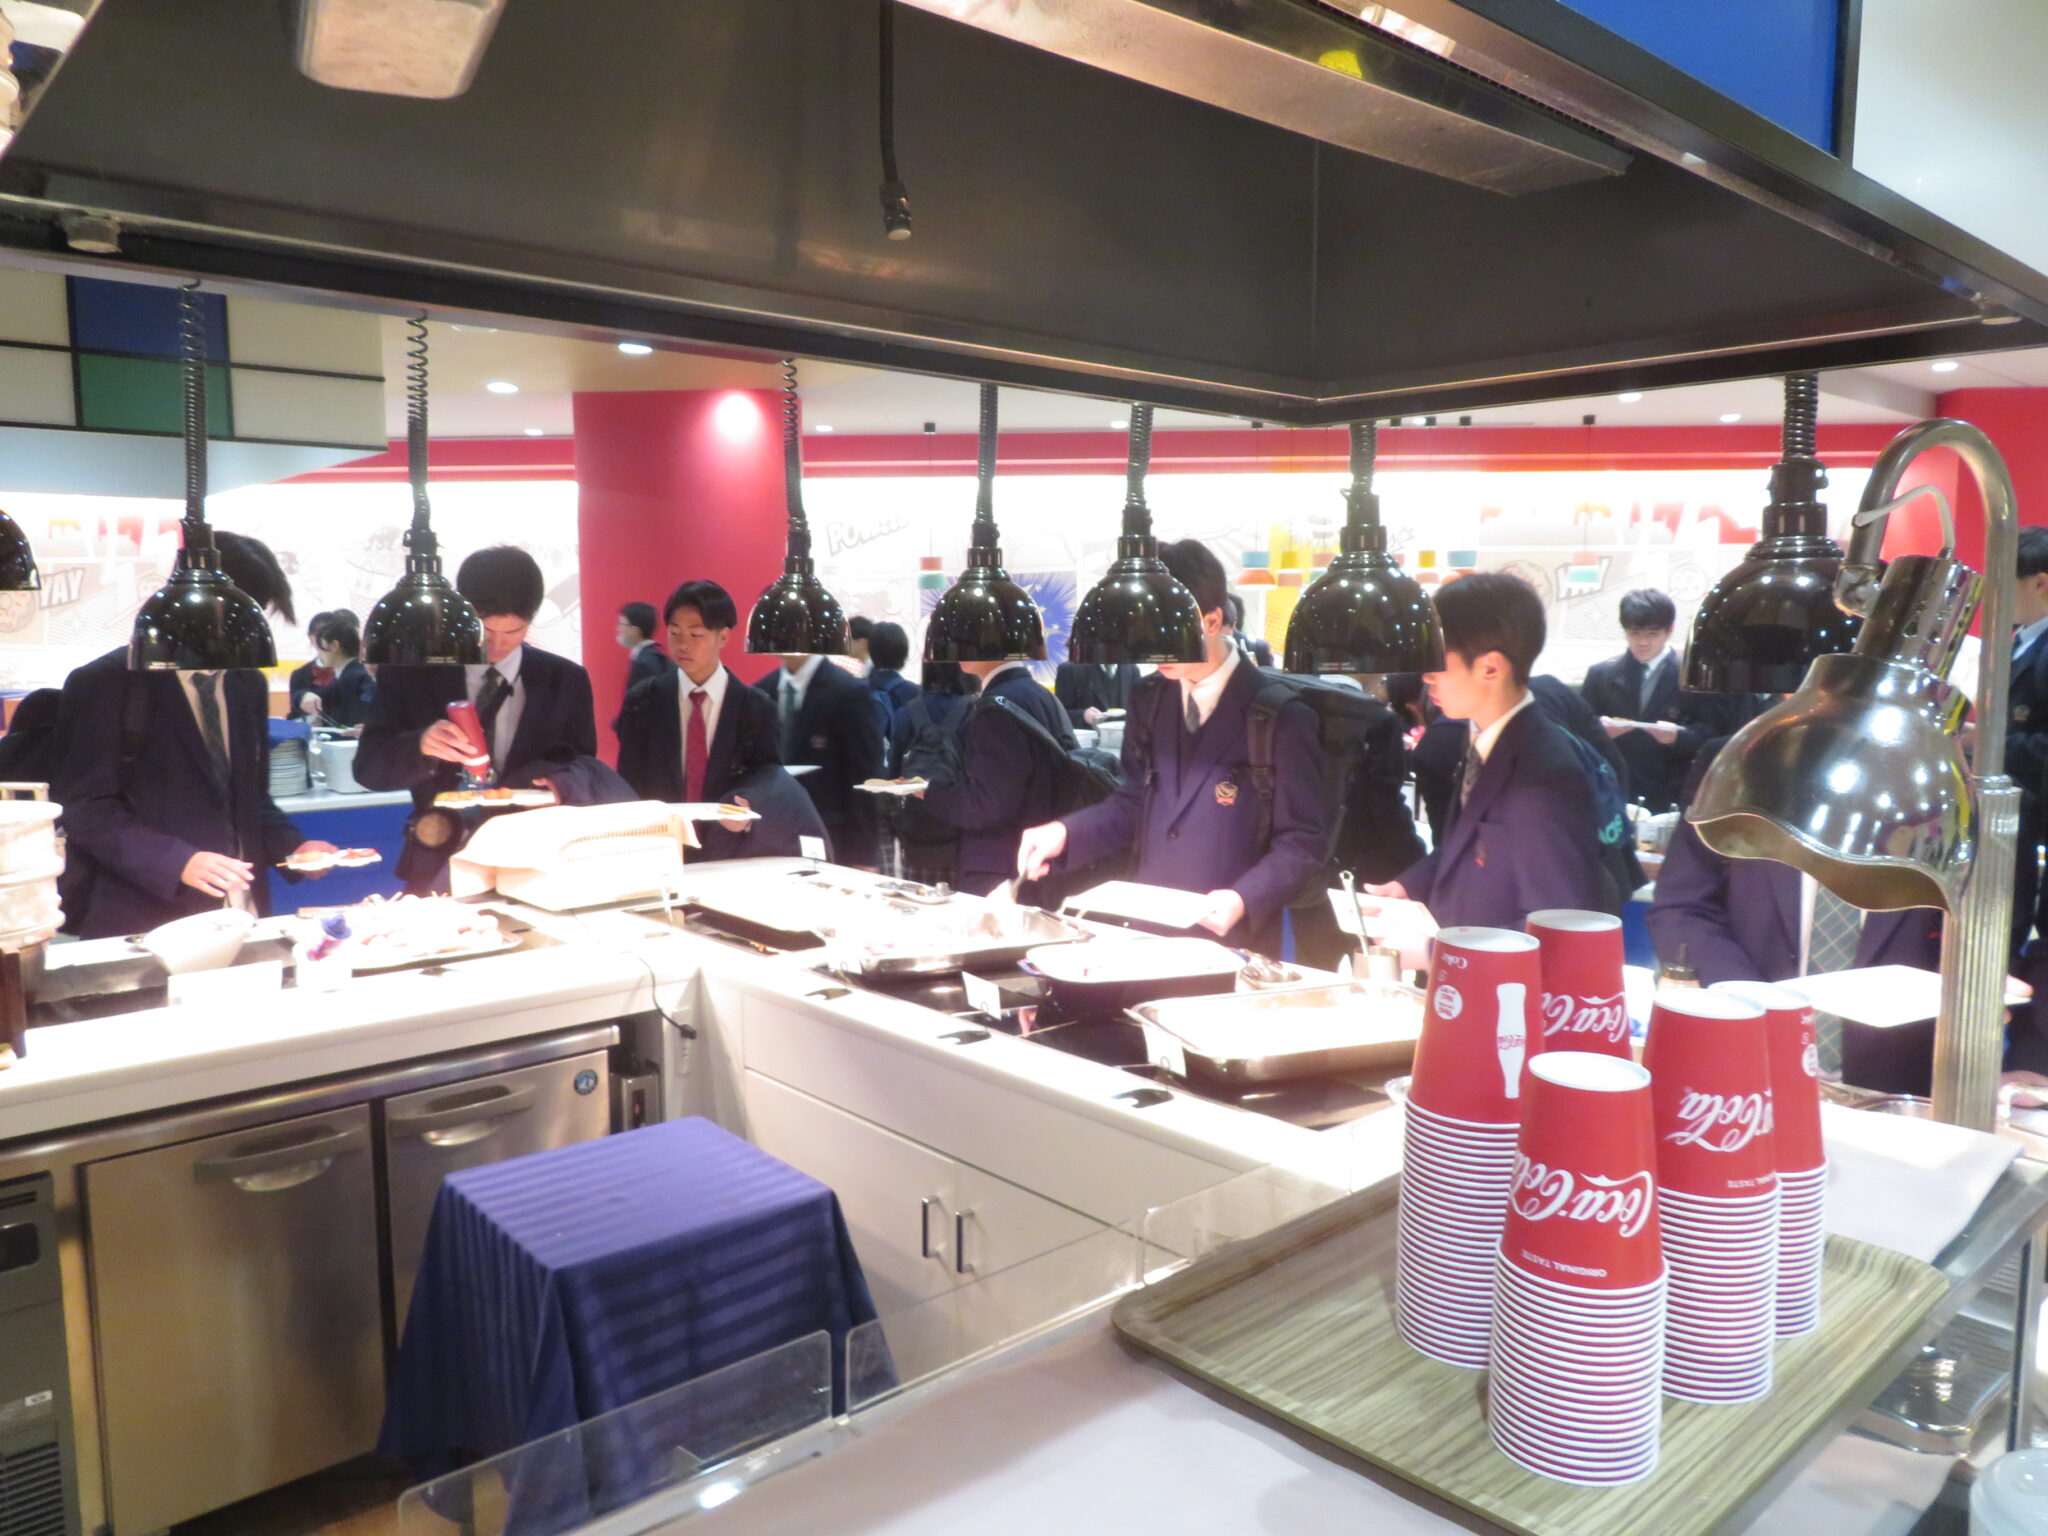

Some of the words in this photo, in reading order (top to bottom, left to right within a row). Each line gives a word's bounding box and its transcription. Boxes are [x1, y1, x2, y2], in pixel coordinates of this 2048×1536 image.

[1541, 991, 1629, 1043] Coca-Co
[1508, 1151, 1654, 1238] Coca-Col
[1520, 1248, 1553, 1268] TASTE
[1551, 1259, 1608, 1278] ORIGINAL
